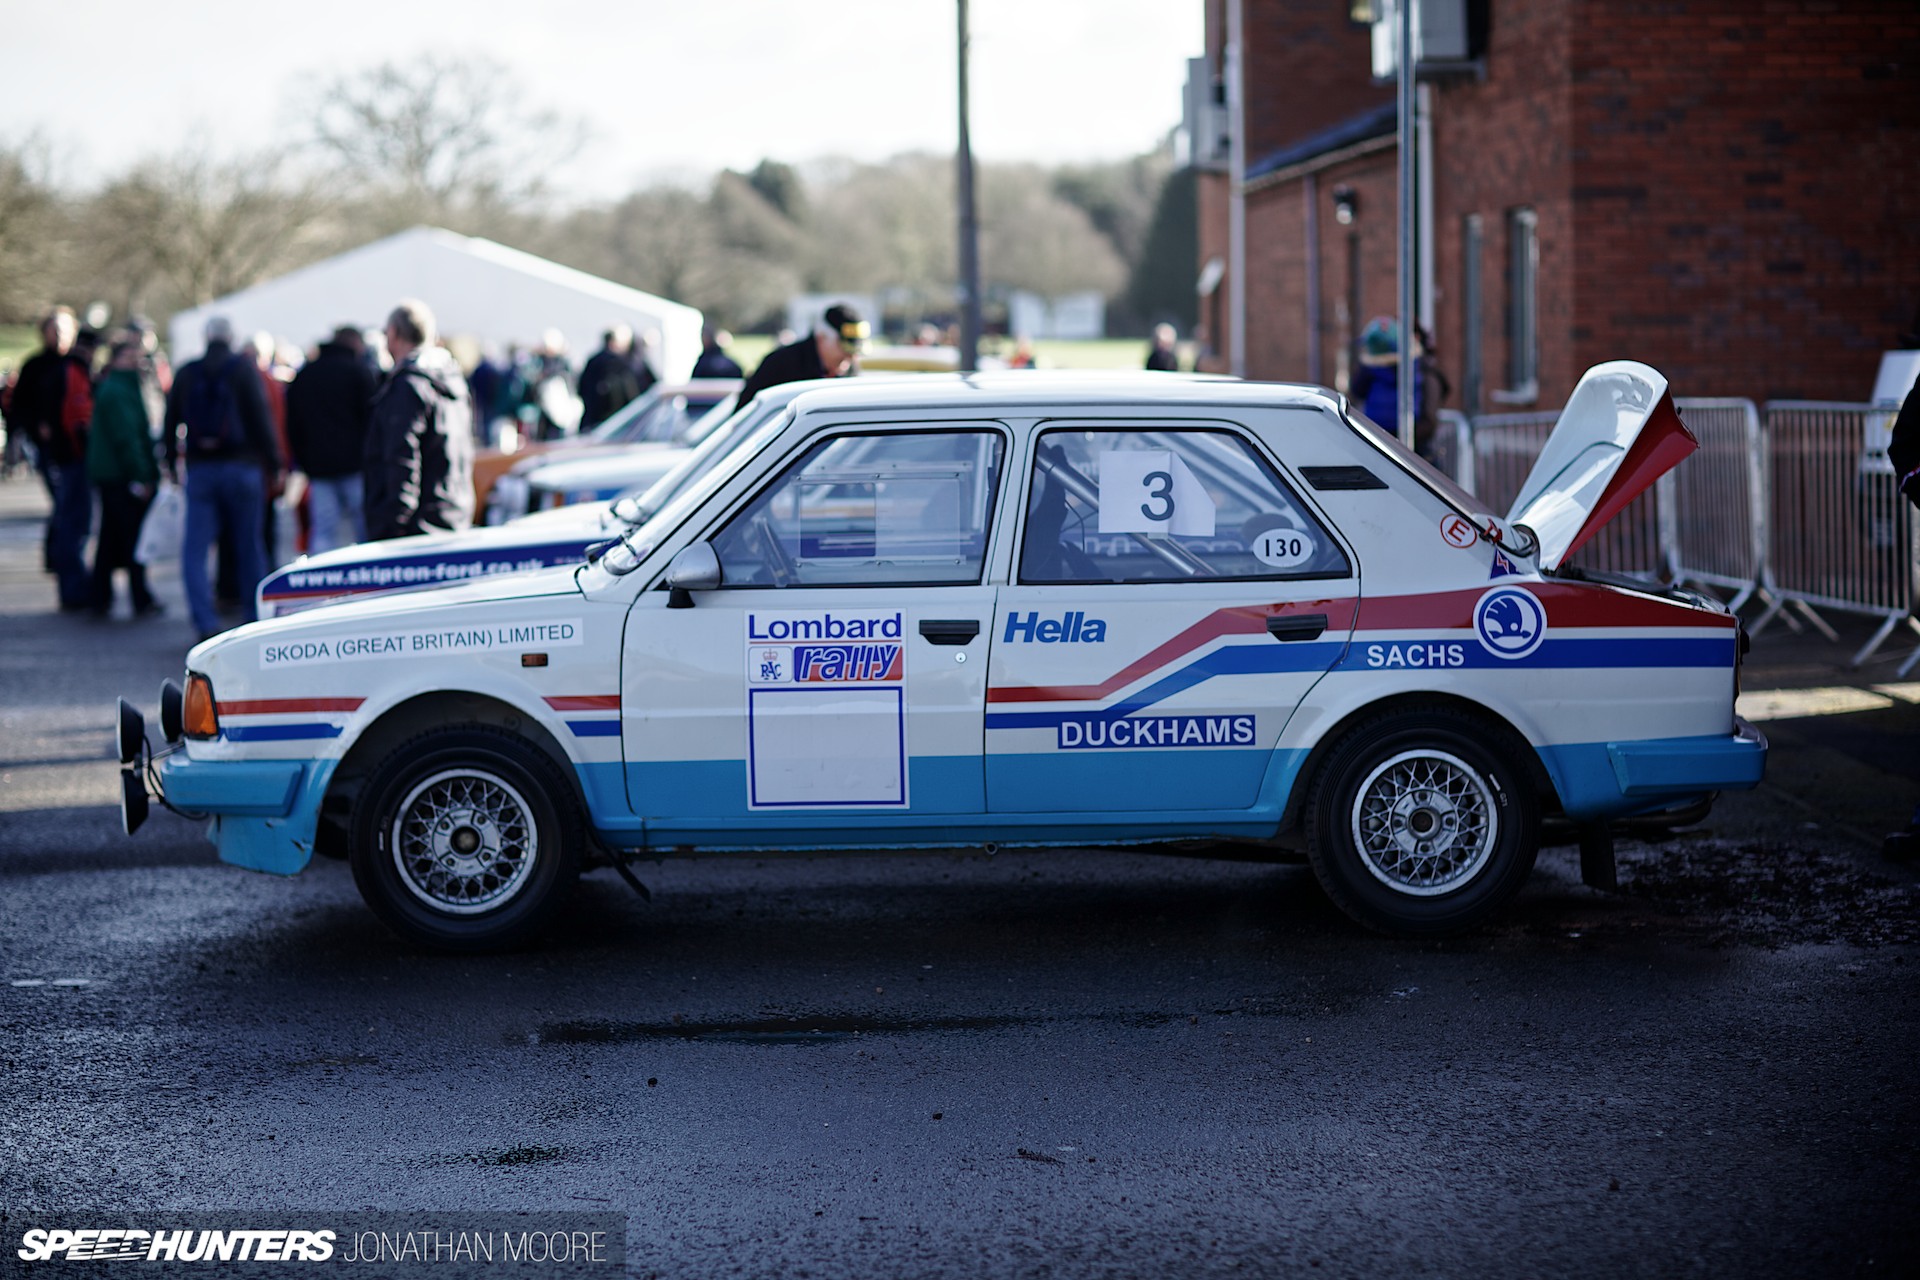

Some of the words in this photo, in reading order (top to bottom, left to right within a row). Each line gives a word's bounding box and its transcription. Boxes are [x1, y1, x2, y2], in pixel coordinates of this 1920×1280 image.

[1141, 471, 1175, 521] 3
[1448, 519, 1470, 542] E
[1265, 538, 1301, 557] 130
[288, 558, 545, 588] www.skipton-ford.co.uk
[749, 613, 902, 639] Lombard
[1003, 611, 1107, 643] Hella
[265, 642, 330, 663] SKODA
[335, 635, 406, 661] (GREAT
[412, 629, 493, 652] BRITAIN)
[498, 624, 574, 645] LIMITED
[1367, 644, 1465, 667] SACHS
[760, 661, 782, 680] RAC
[799, 644, 901, 681] rally
[1061, 717, 1254, 746] DUCKHAMS
